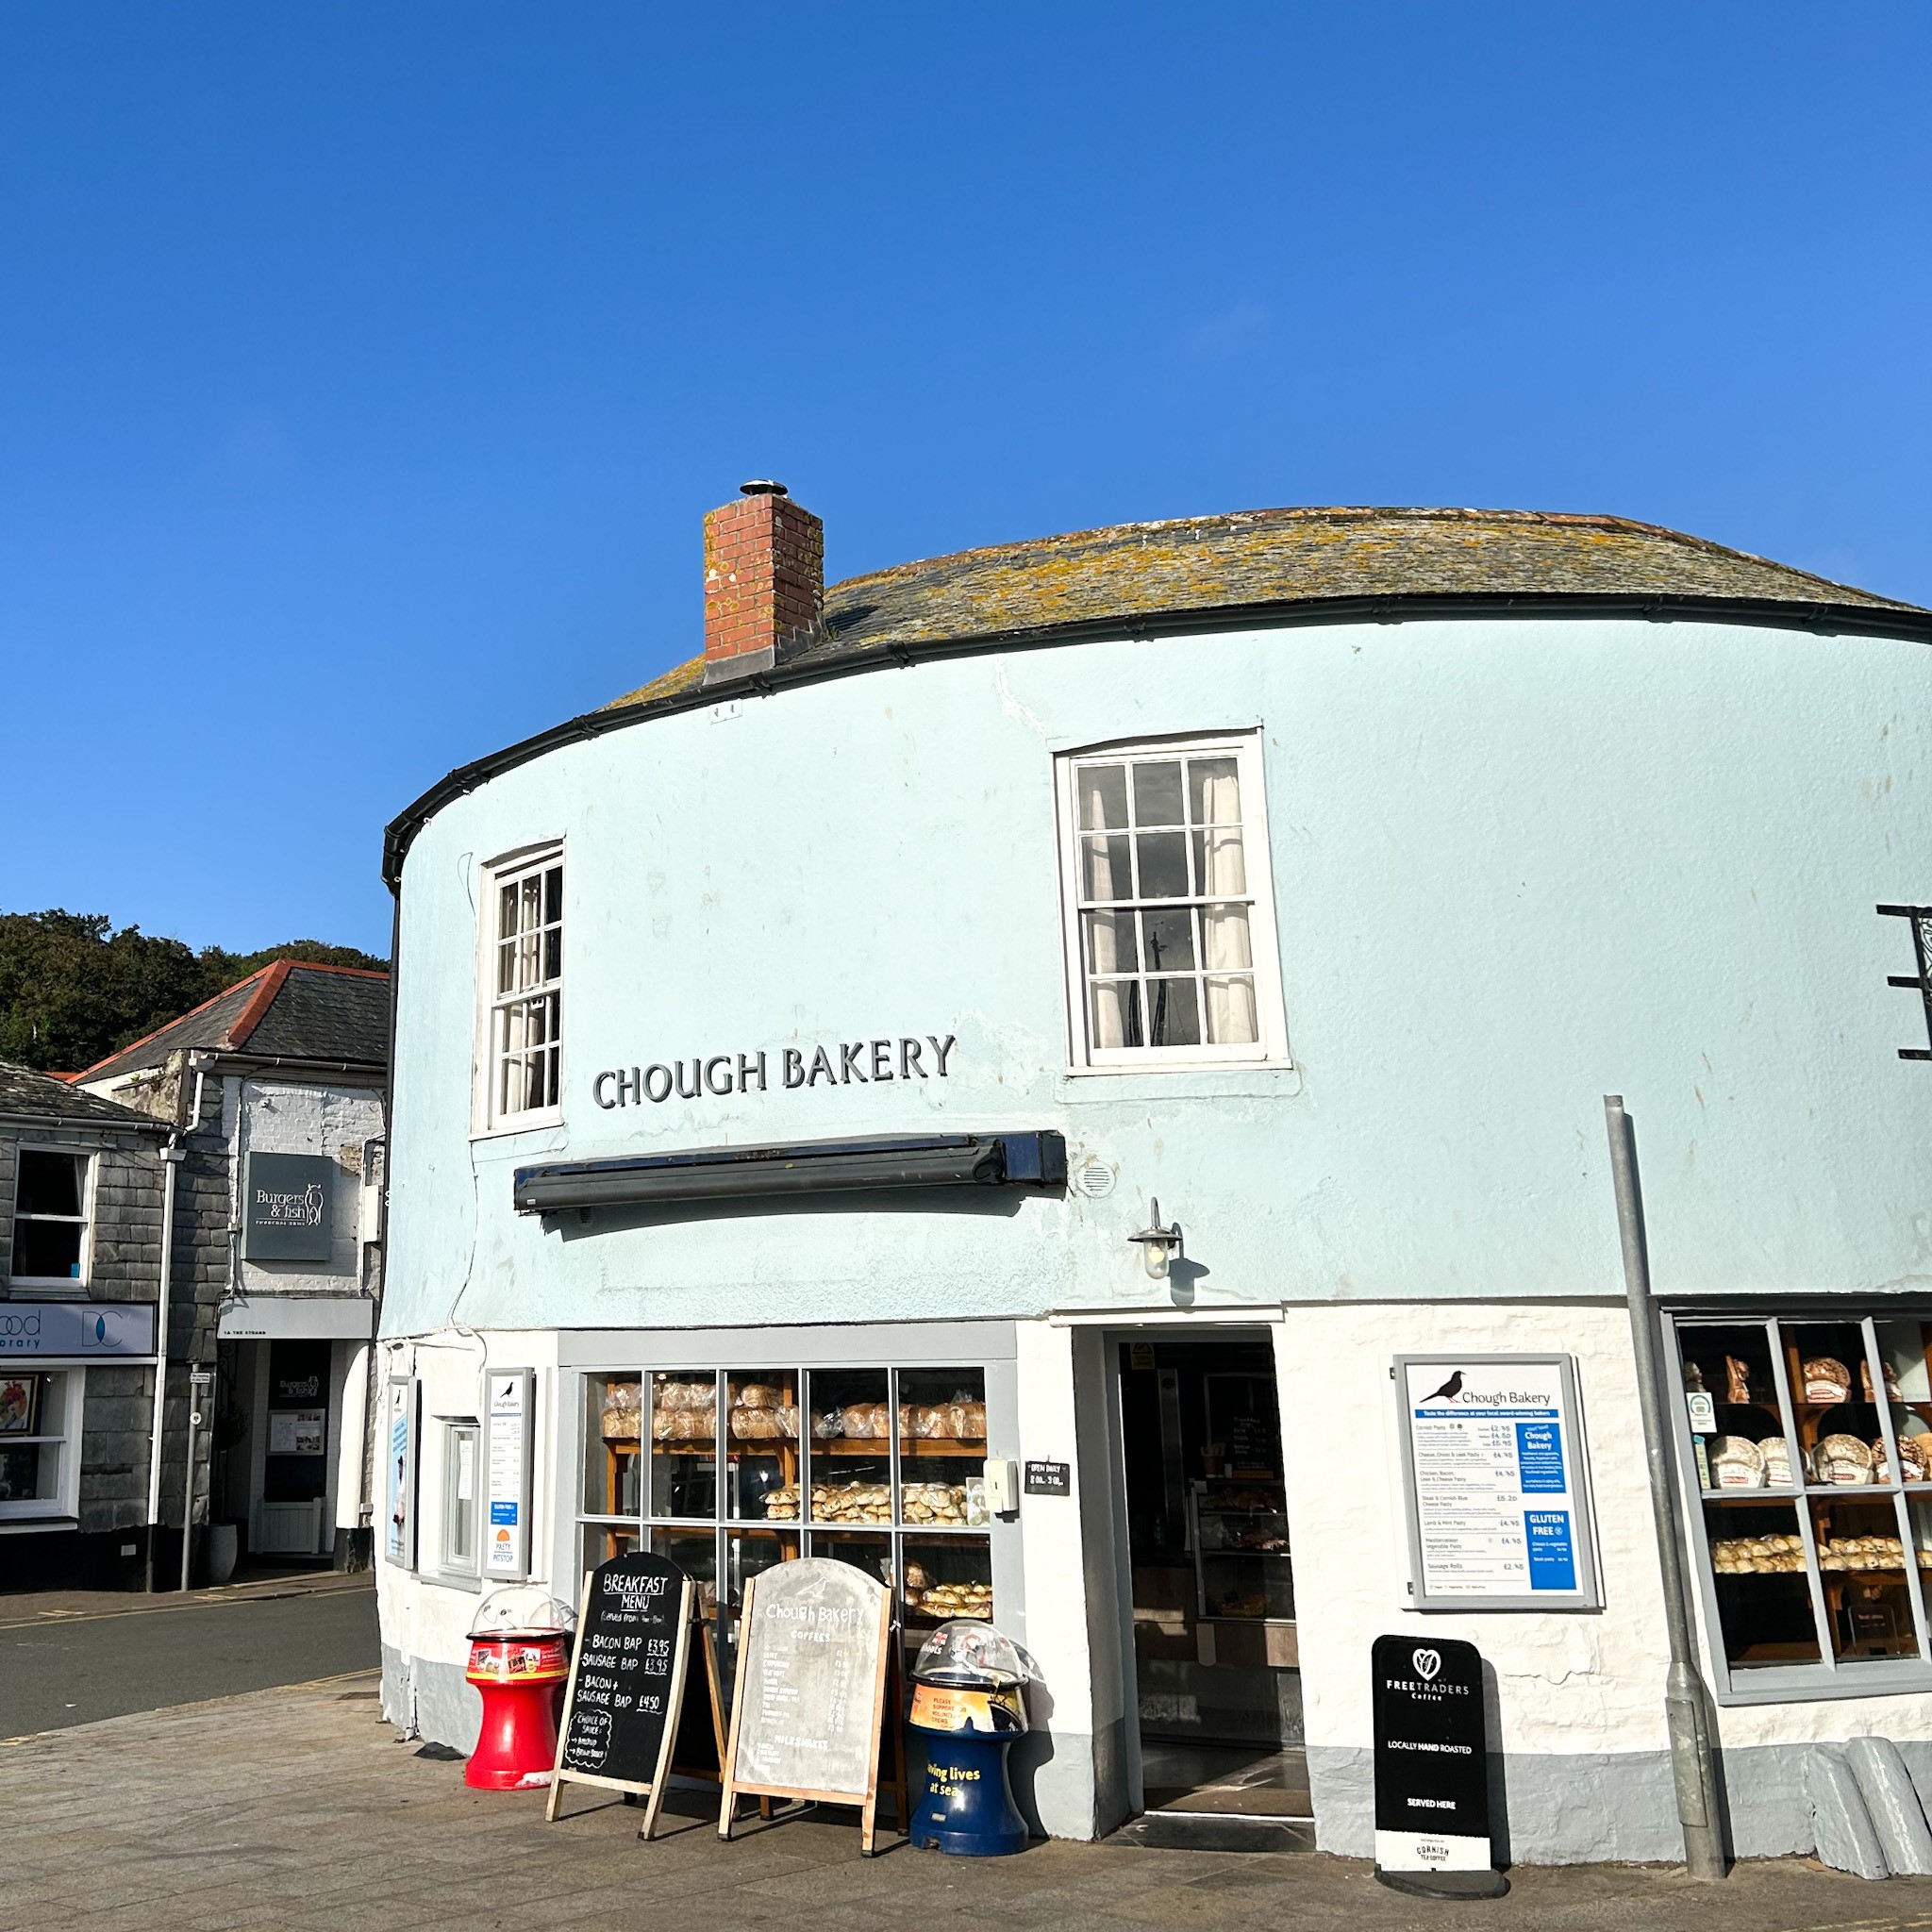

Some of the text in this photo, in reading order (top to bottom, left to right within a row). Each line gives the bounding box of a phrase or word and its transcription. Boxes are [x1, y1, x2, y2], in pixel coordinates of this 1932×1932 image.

[592, 1034, 958, 1109] CHOUGH BAKERY
[256, 1189, 305, 1208] Burgers
[270, 1204, 307, 1219] & fish
[1462, 1391, 1551, 1406] Chough Bakery
[1524, 1432, 1552, 1441] Chough
[1527, 1441, 1552, 1451] Bakery
[1529, 1514, 1565, 1524] GLUTEN
[1532, 1525, 1555, 1536] FREE
[603, 1574, 669, 1593] BREAKFAST
[621, 1594, 650, 1609] MENU
[765, 1603, 865, 1624] Chough Bakery
[592, 1634, 622, 1650] BACON
[624, 1637, 642, 1651] BAP
[790, 1629, 831, 1642] COFFEES
[621, 1657, 639, 1671] BAP
[584, 1675, 611, 1690] BACON
[576, 1690, 609, 1706] SAUSAGE
[614, 1693, 632, 1708] BAP
[599, 1717, 608, 1726] OF
[1388, 1740, 1472, 1755] LOCALLY HAND ROASTED
[949, 1766, 981, 1781] lives
[929, 1782, 960, 1797] at sea
[1407, 1798, 1457, 1809] SERVED HERE
[1416, 1845, 1450, 1857] CORNISH
